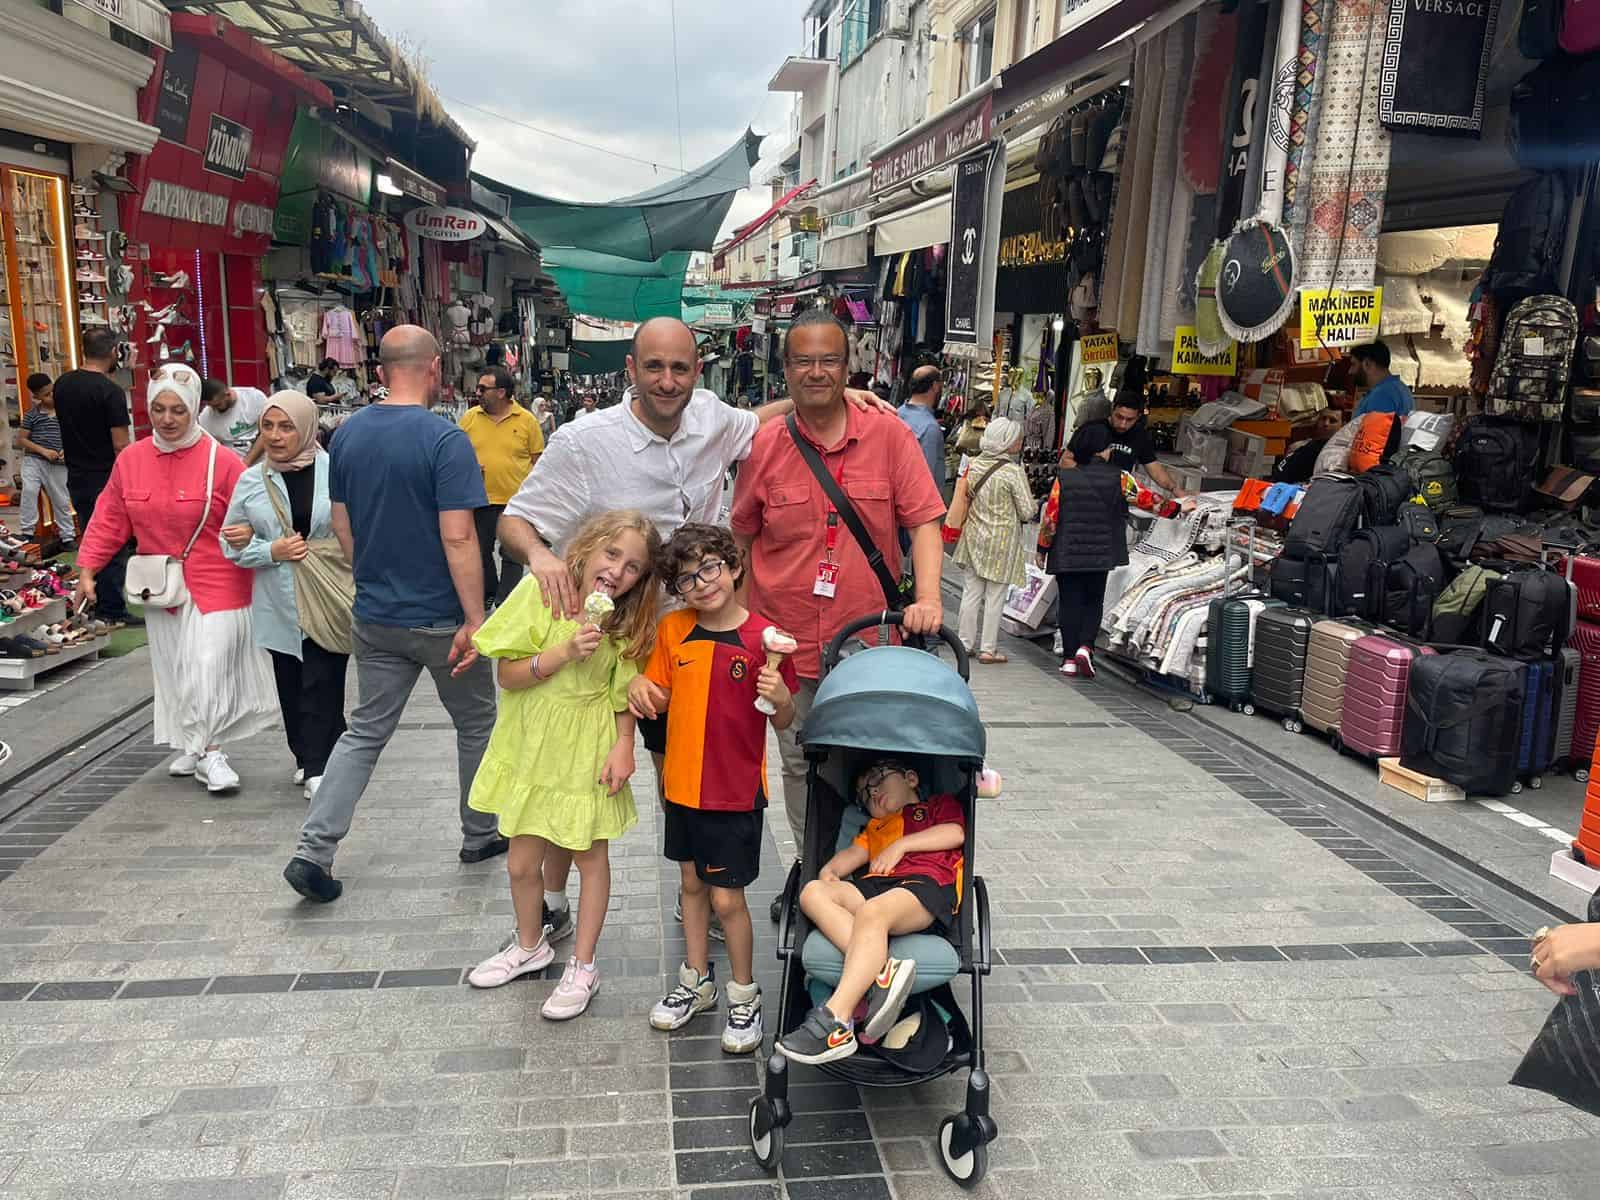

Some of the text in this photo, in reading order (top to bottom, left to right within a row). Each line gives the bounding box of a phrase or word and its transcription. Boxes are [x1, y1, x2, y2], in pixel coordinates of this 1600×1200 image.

[1415, 0, 1484, 17] VERSACE
[901, 136, 936, 177] SULTAN
[1309, 295, 1375, 312] MAKİNEDE
[1083, 335, 1115, 348] YATAK
[1327, 327, 1356, 341] HALI
